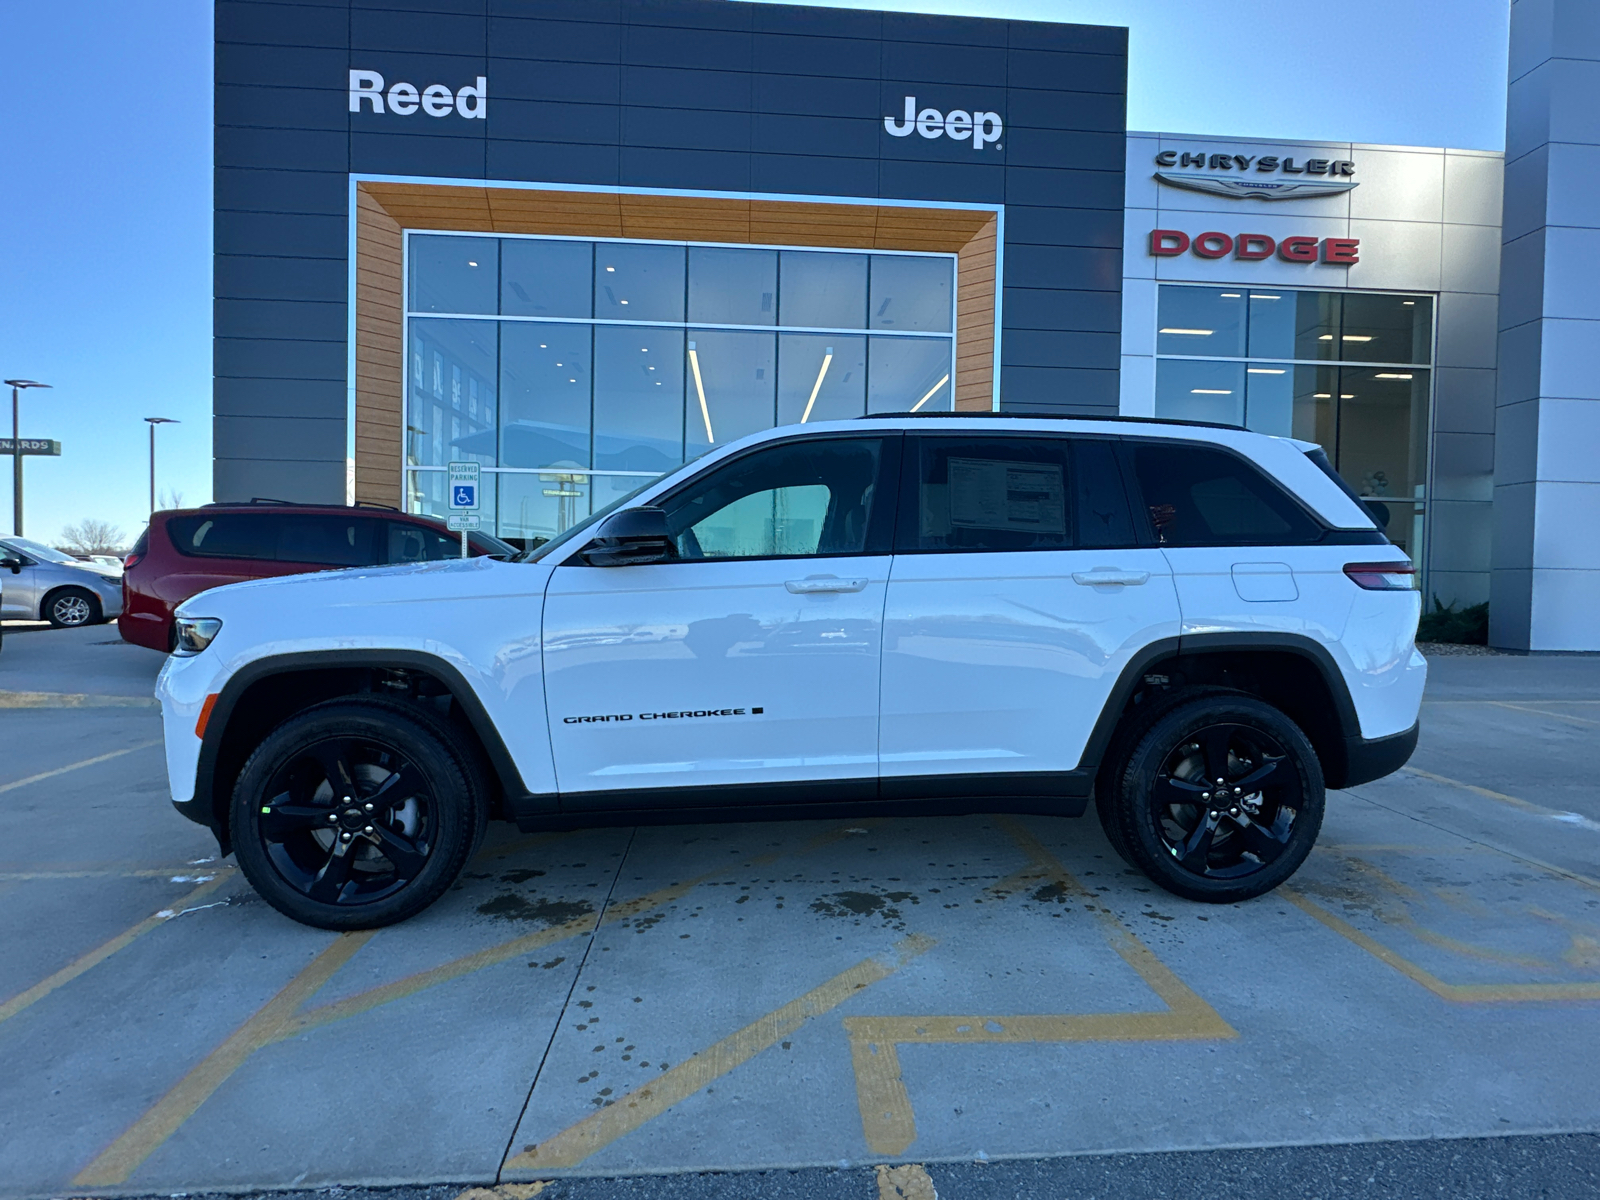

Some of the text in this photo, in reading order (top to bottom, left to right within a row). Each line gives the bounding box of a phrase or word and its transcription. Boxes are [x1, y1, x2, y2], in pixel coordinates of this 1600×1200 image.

[349, 69, 487, 119] Reed
[884, 96, 1003, 150] Jeep
[1156, 150, 1356, 175] CHRYSLER
[1150, 229, 1360, 265] DODGE
[0, 441, 49, 449] NRDS
[563, 708, 746, 724] GRAND CHEROKEE
